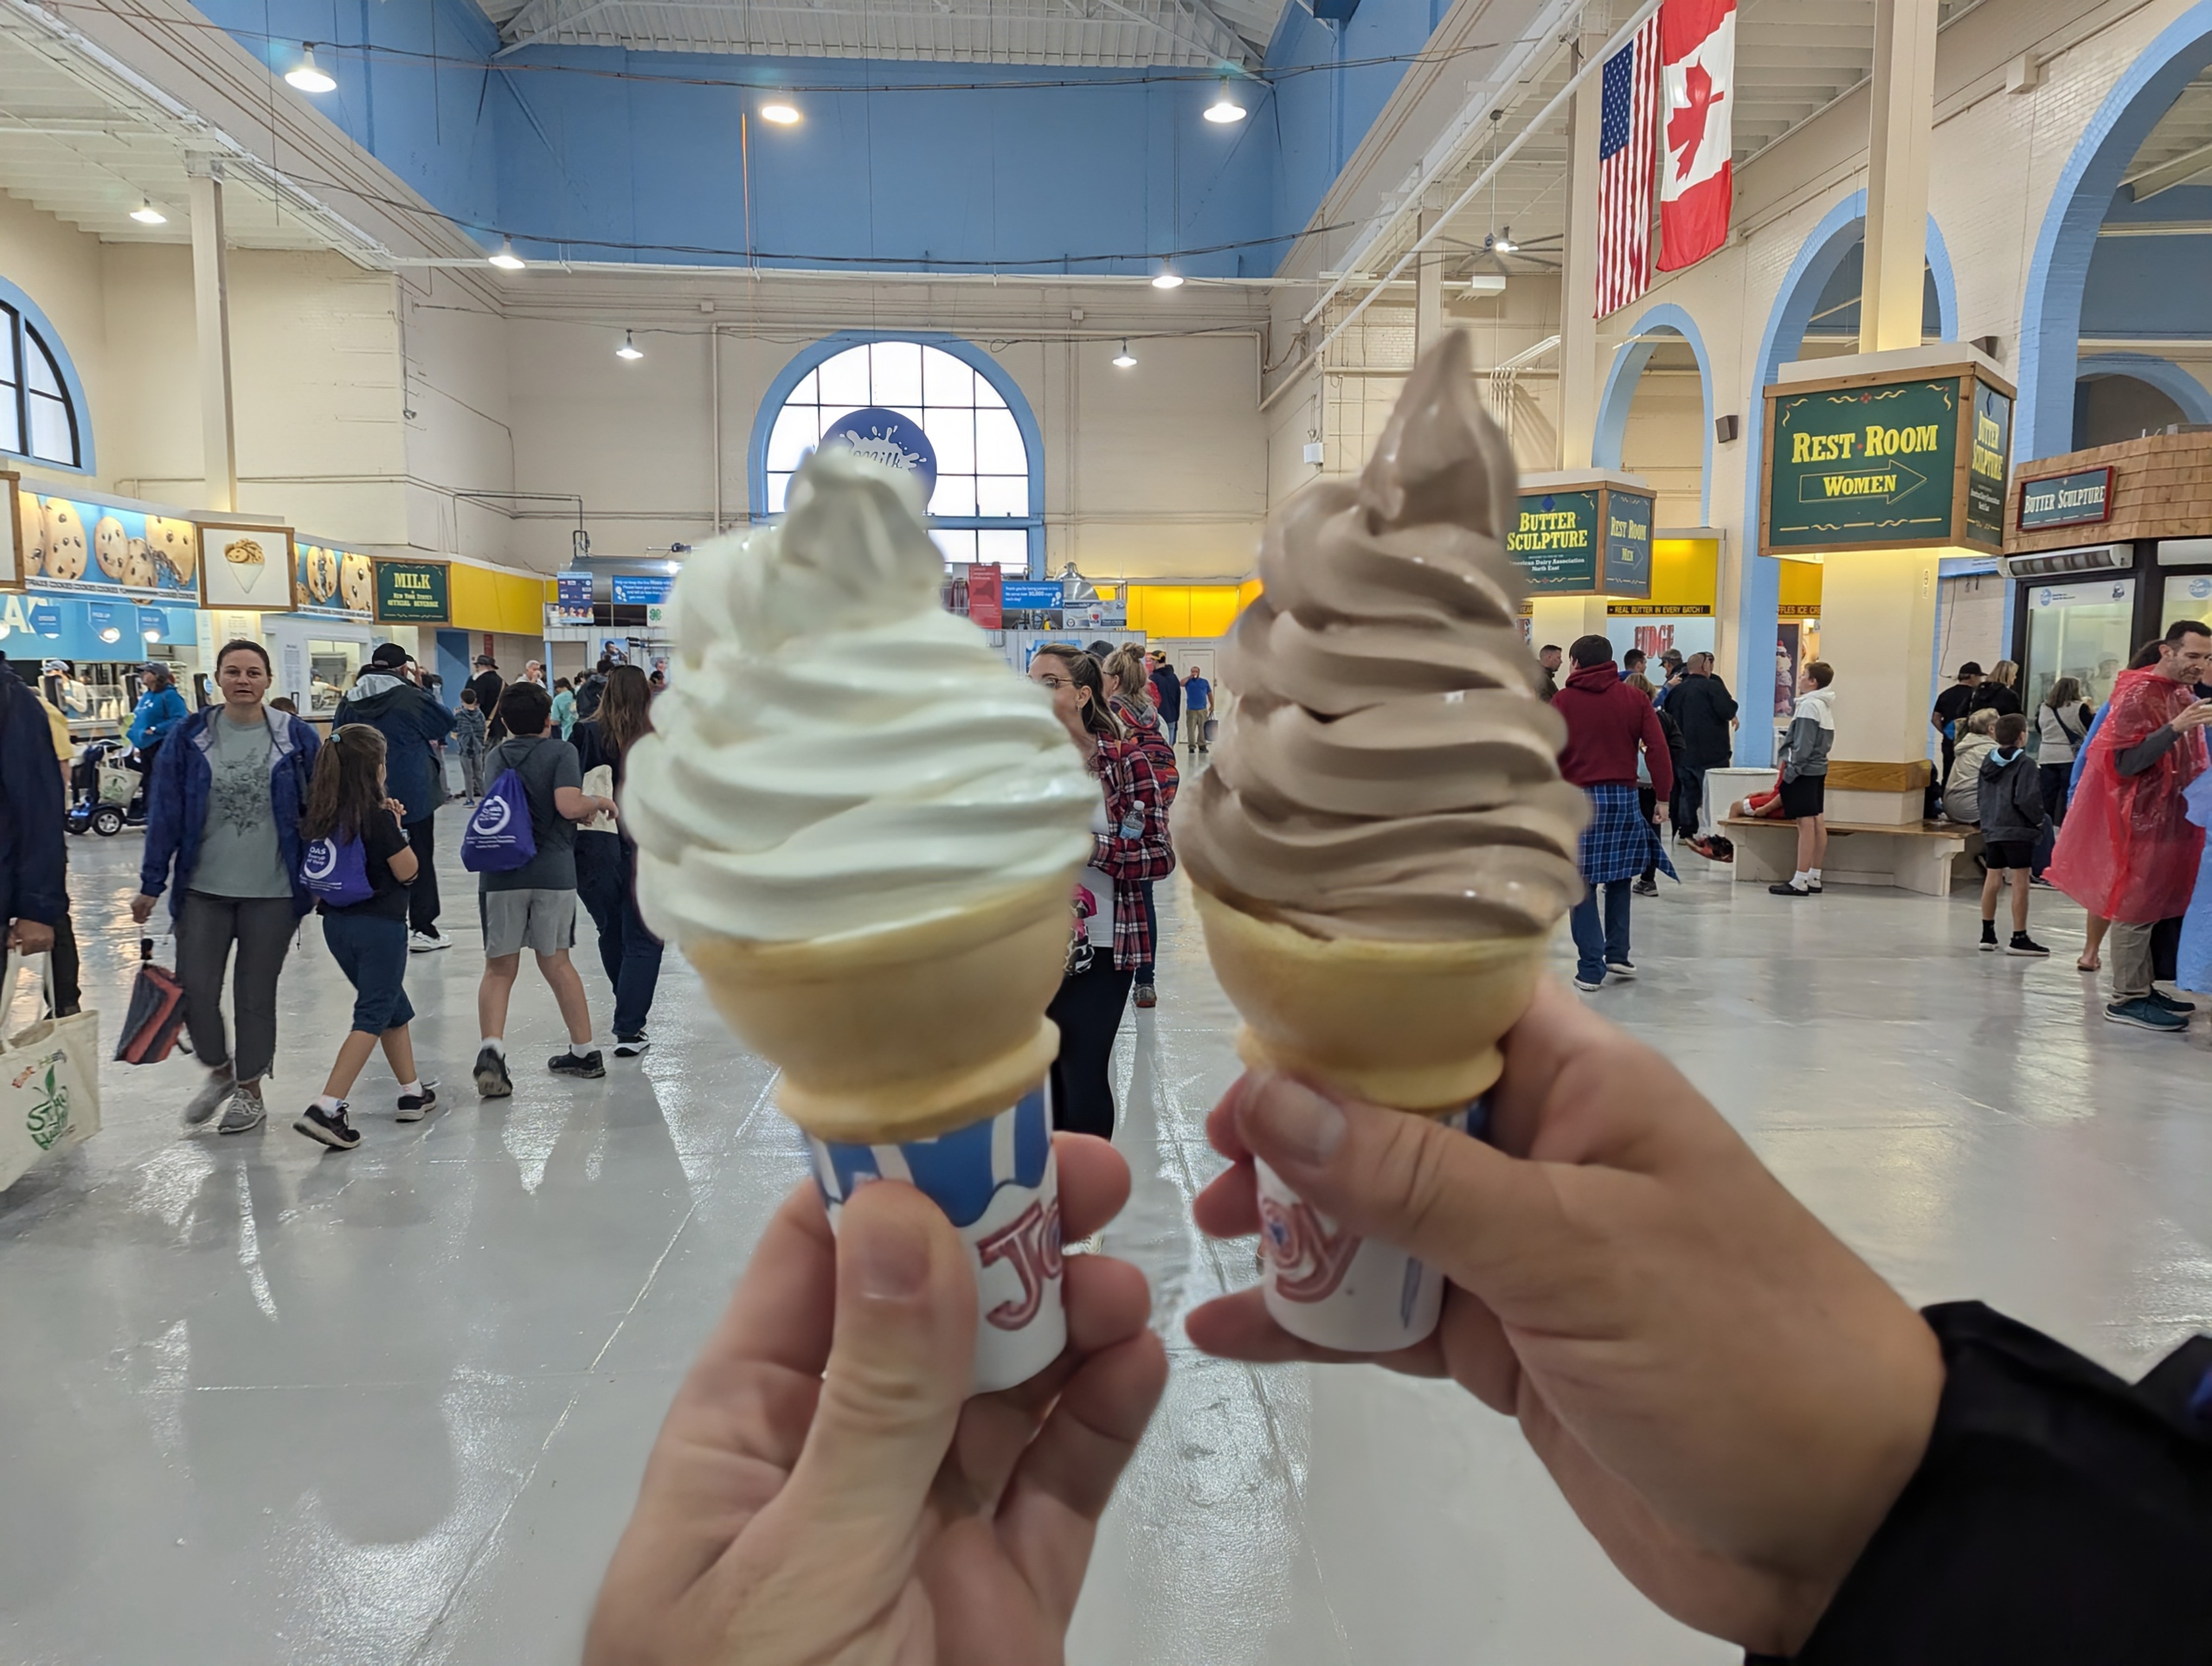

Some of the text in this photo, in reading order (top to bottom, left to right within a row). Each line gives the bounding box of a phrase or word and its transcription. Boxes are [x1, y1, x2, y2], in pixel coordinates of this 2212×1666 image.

[1792, 425, 1938, 463] REST ROOM
[1823, 475, 1897, 497] WOMEN
[2024, 486, 2106, 514] BUTTER SCULPTURE
[1519, 511, 1576, 531] BUTTER
[1611, 517, 1647, 541] REST ROOM
[1507, 530, 1587, 551] SCULPTURE
[1622, 547, 1634, 562] MEN
[394, 573, 431, 589] MILK
[1635, 624, 1674, 658] FUDGE
